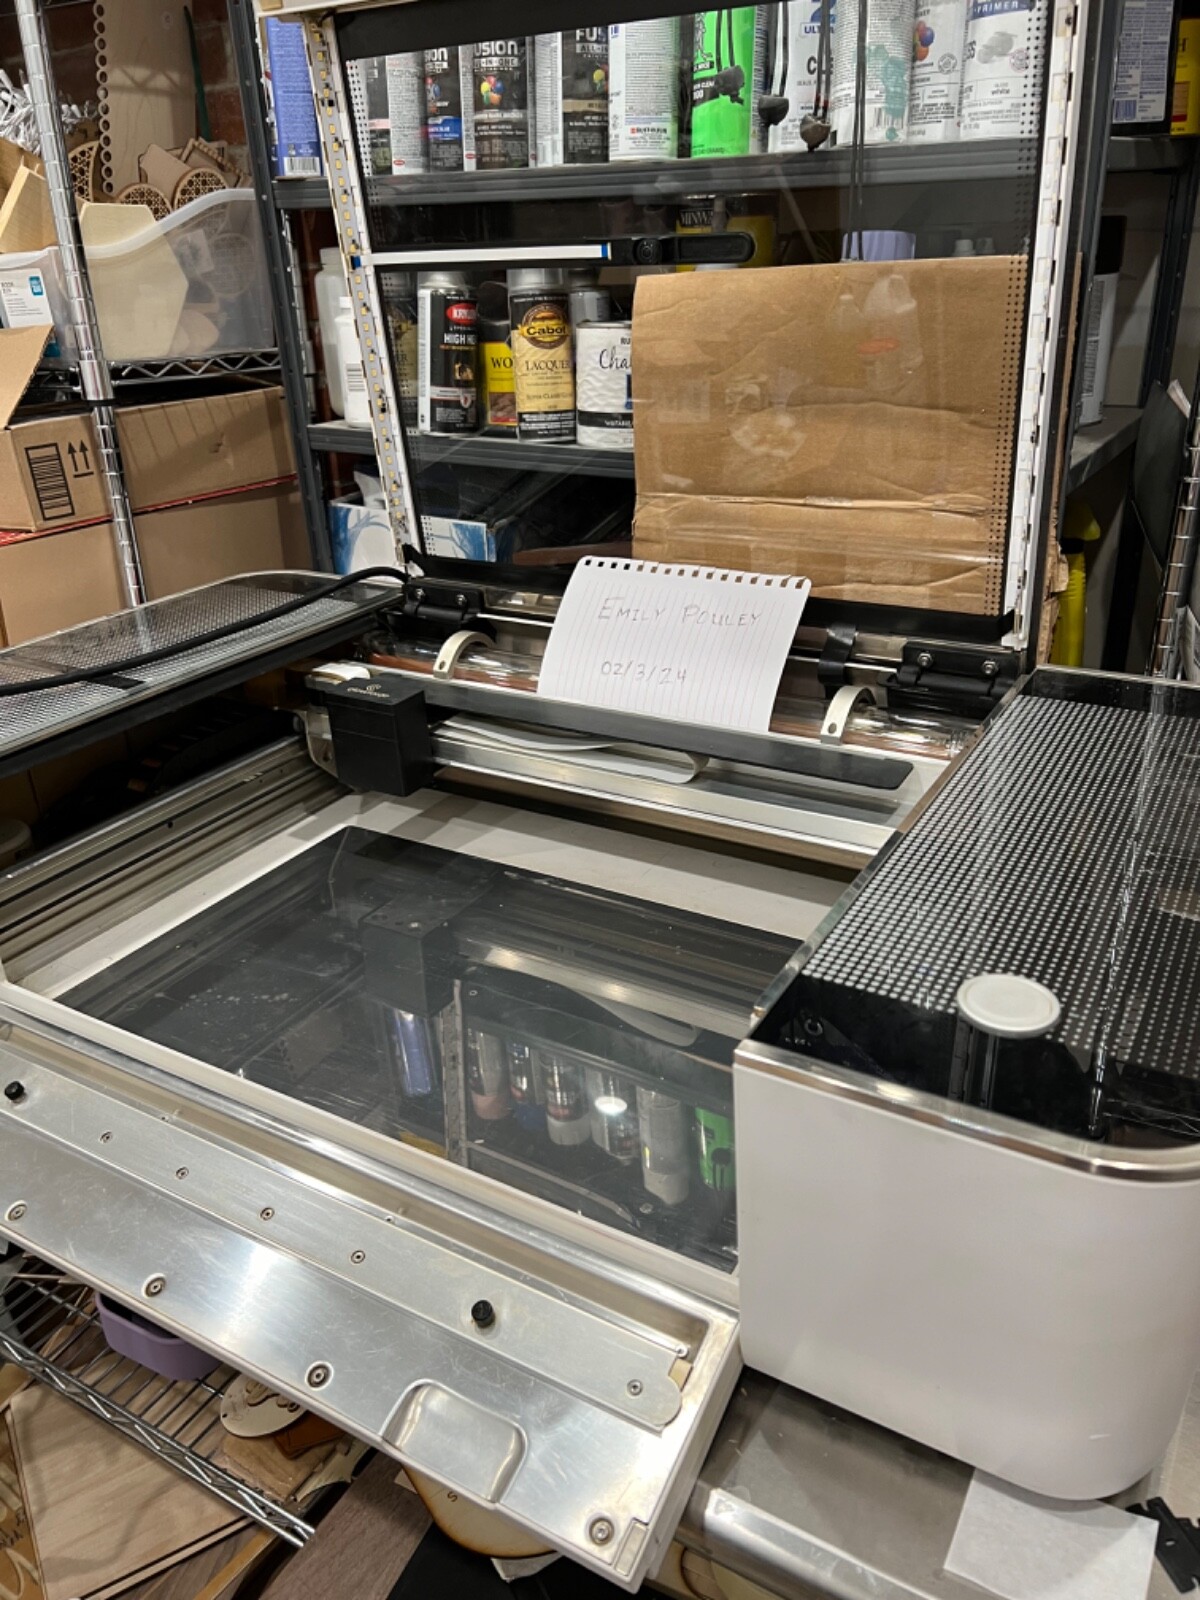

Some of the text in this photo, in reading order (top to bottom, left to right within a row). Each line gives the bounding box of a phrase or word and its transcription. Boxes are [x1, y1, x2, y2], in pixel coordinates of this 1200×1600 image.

[976, 1, 1019, 14] PRIMER
[681, 210, 714, 225] MINWA
[491, 357, 513, 369] WO
[598, 597, 666, 621] EMILY
[601, 660, 687, 684] 02/3/24
